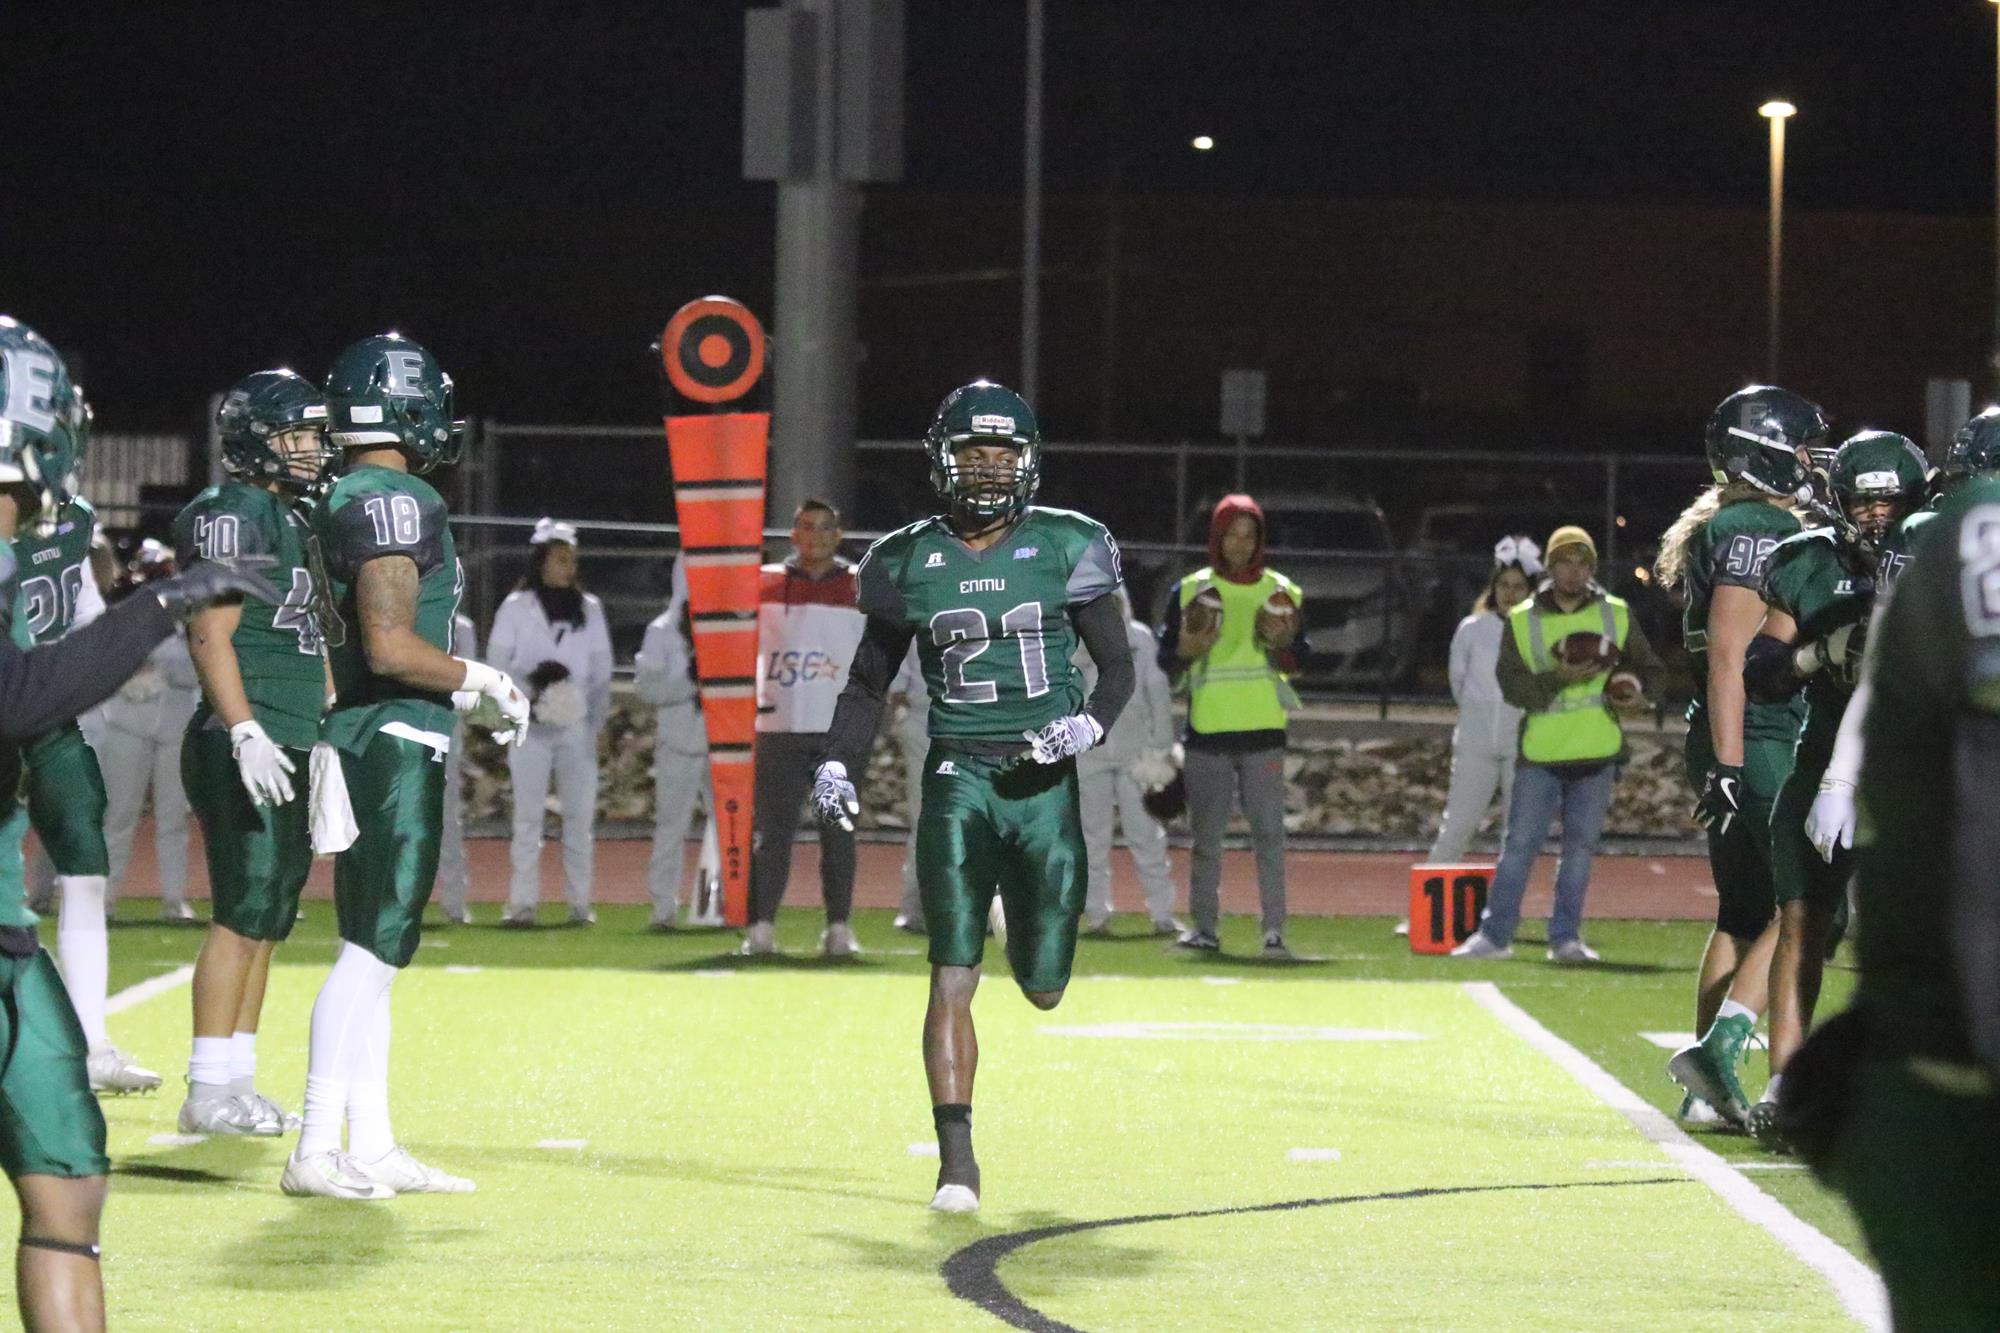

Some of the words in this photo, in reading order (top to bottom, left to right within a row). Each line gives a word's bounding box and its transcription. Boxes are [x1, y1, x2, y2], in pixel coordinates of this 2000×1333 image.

[3, 351, 55, 434] E
[385, 352, 425, 398] E
[194, 515, 238, 559] 40
[364, 496, 420, 545] 18
[930, 601, 1050, 703] 21
[1424, 876, 1487, 944] 10
